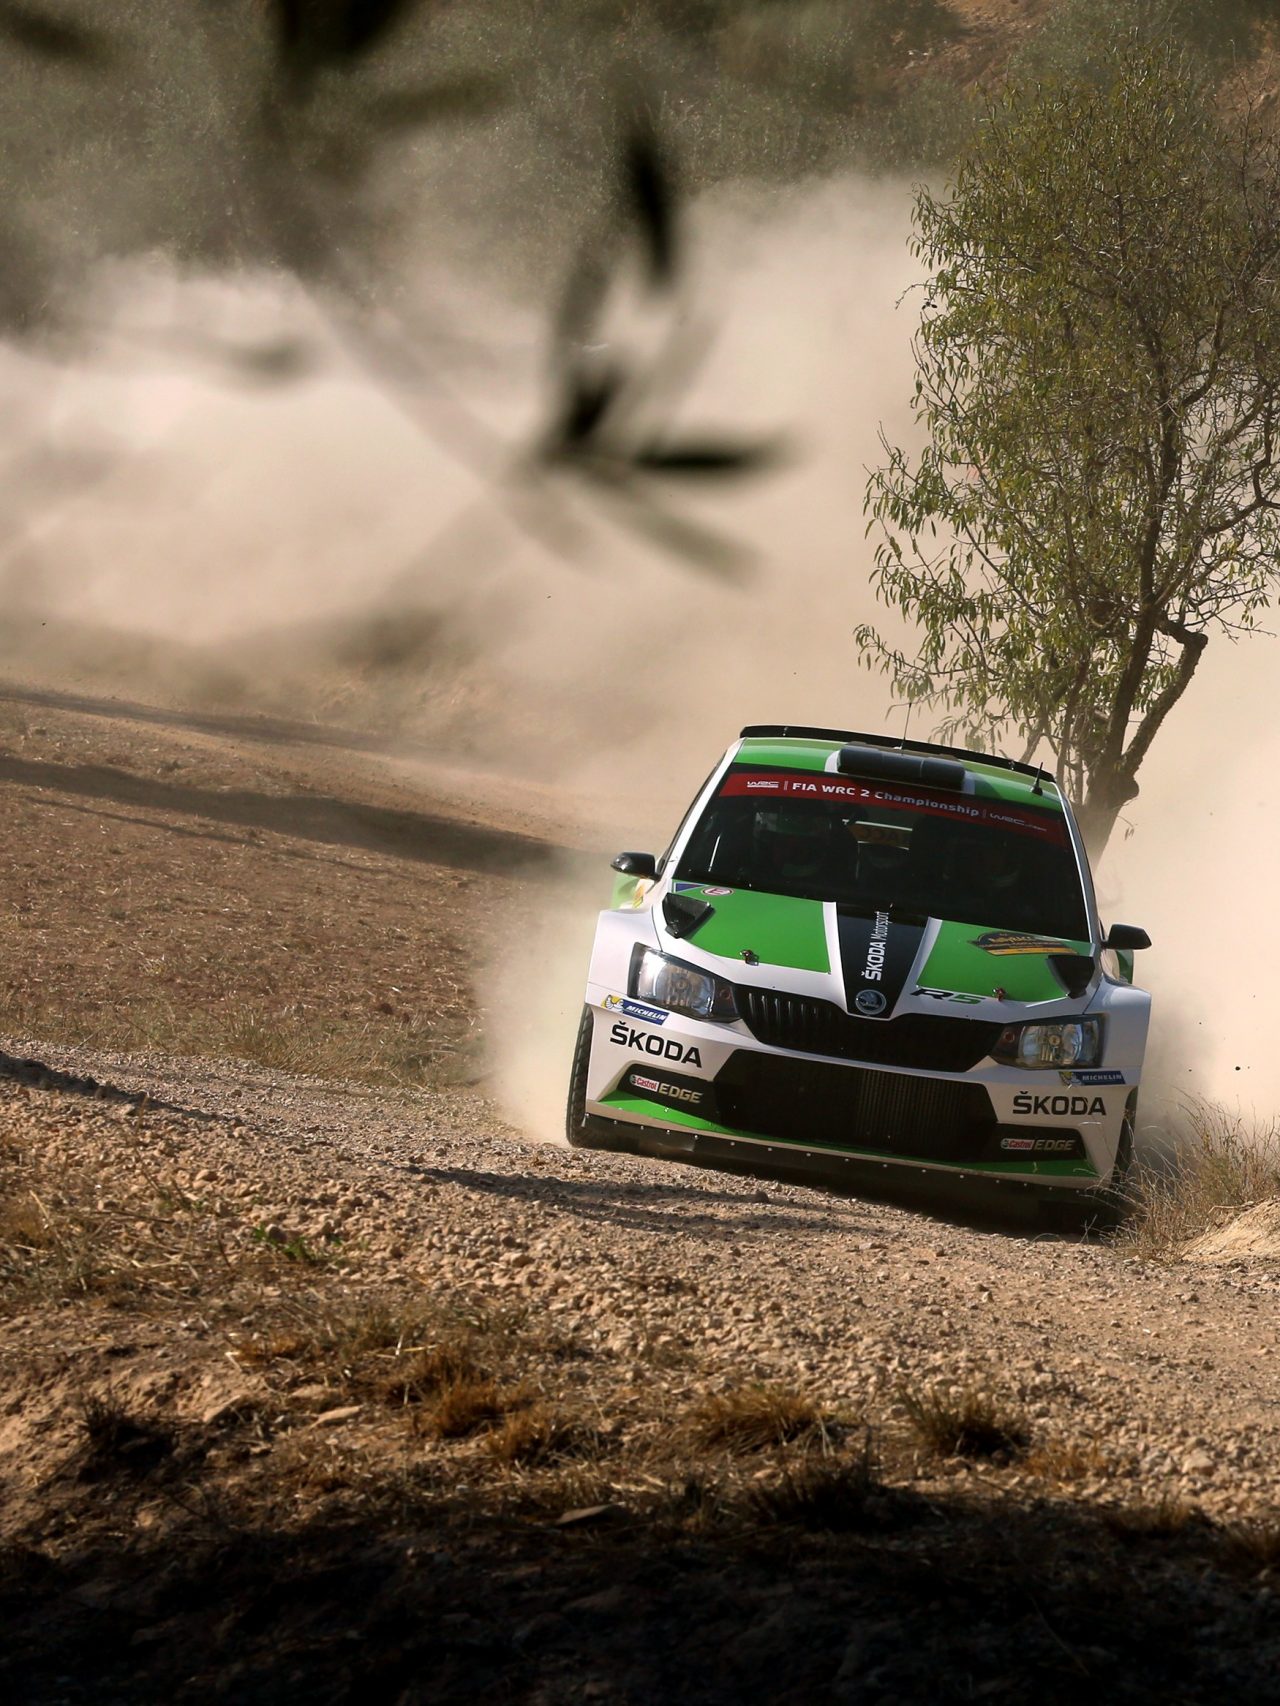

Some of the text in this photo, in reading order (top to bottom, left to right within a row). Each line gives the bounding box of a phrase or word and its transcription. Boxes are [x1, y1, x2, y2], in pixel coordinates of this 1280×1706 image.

[792, 782, 817, 792] FIA
[822, 785, 856, 796] WRC
[860, 789, 870, 797] 2
[874, 791, 980, 817] Championship
[861, 911, 893, 980] ŠKODA Motorsport
[911, 988, 986, 1005] R5
[626, 1005, 667, 1021] MICHELIN
[610, 1020, 702, 1068] ŠKODA
[636, 1077, 704, 1104] Castrol EDGE
[1012, 1090, 1107, 1116] ŠKODA
[1008, 1139, 1077, 1151] Castrol EDGE
